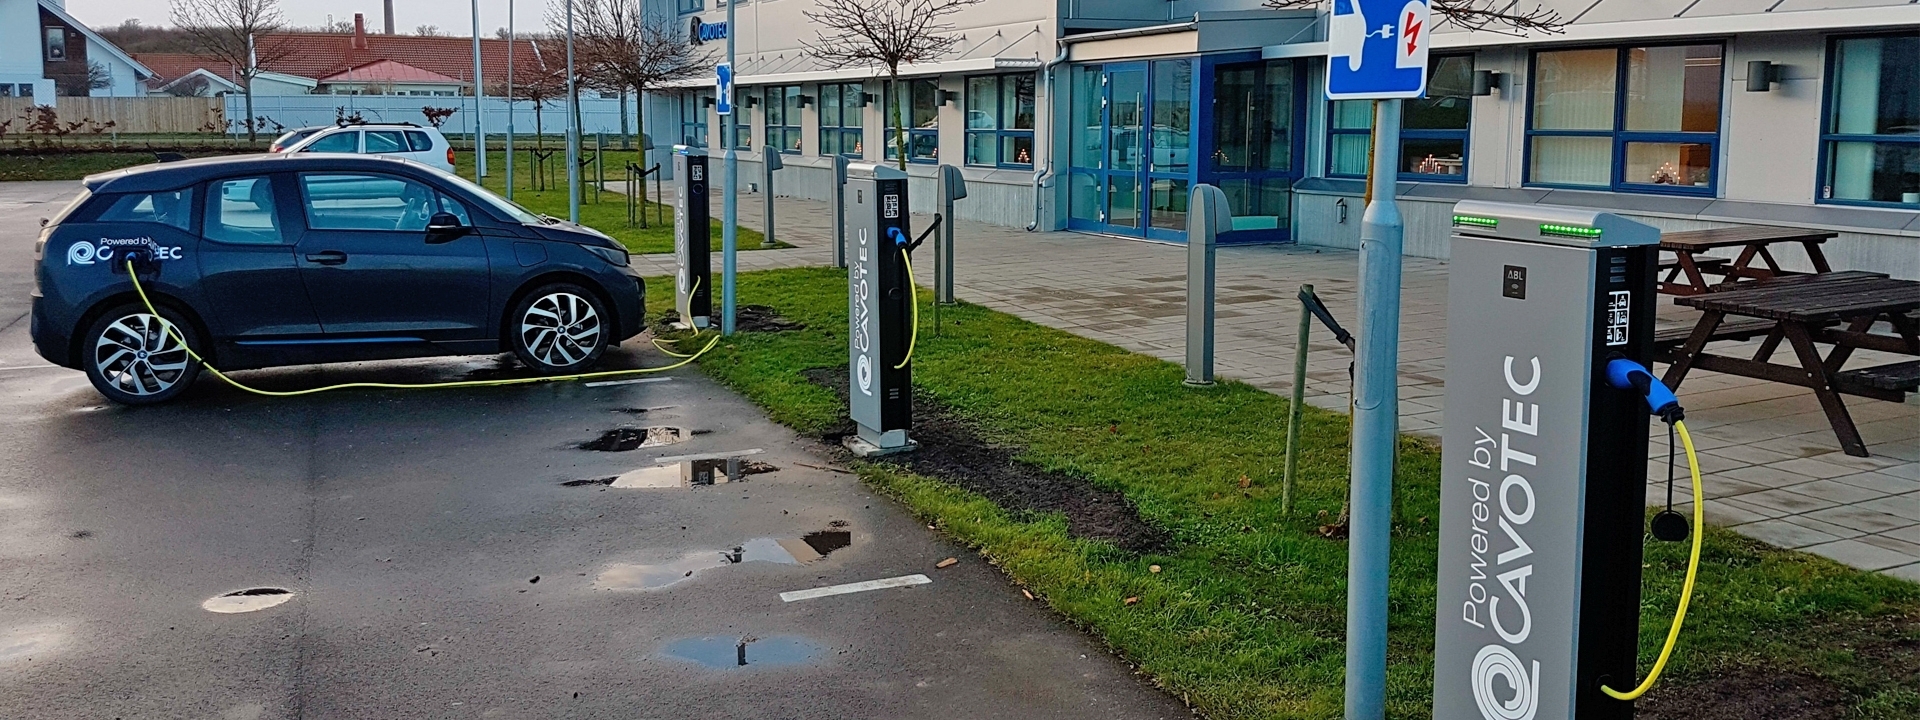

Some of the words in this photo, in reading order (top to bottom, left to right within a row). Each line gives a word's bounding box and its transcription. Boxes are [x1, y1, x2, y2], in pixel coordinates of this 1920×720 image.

[699, 22, 727, 41] CAVOTEC
[100, 238, 140, 246] Powered
[854, 261, 860, 280] by
[1507, 270, 1523, 281] ABL
[859, 228, 869, 353] CAVOTEC
[1467, 426, 1497, 469] by
[1489, 355, 1541, 644] CAVOTEC
[1463, 477, 1490, 629] Powered
